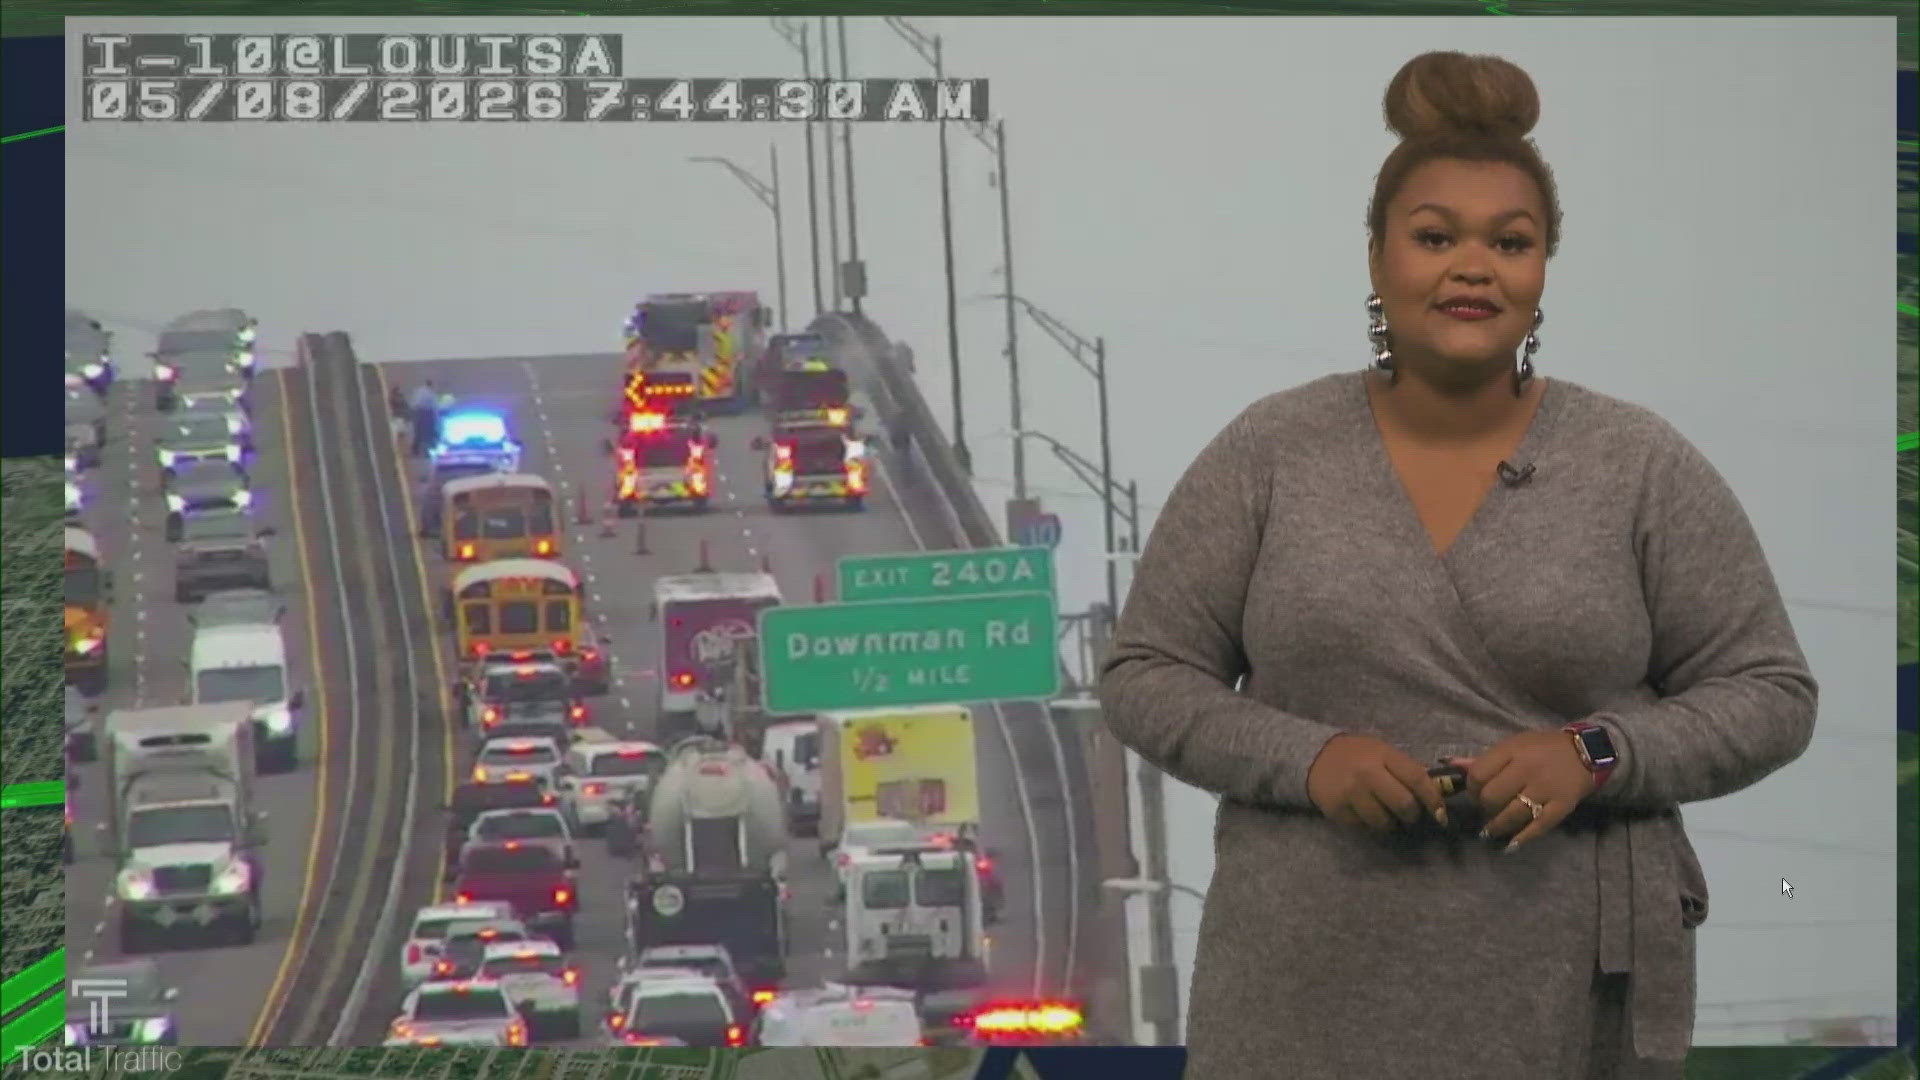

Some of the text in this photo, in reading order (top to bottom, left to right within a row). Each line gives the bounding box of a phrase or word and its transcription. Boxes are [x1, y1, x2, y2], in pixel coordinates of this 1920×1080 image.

[855, 558, 1034, 588] EXIT 240A
[787, 627, 965, 660] Downman
[985, 619, 1030, 648] Rd
[908, 664, 971, 687] MILE
